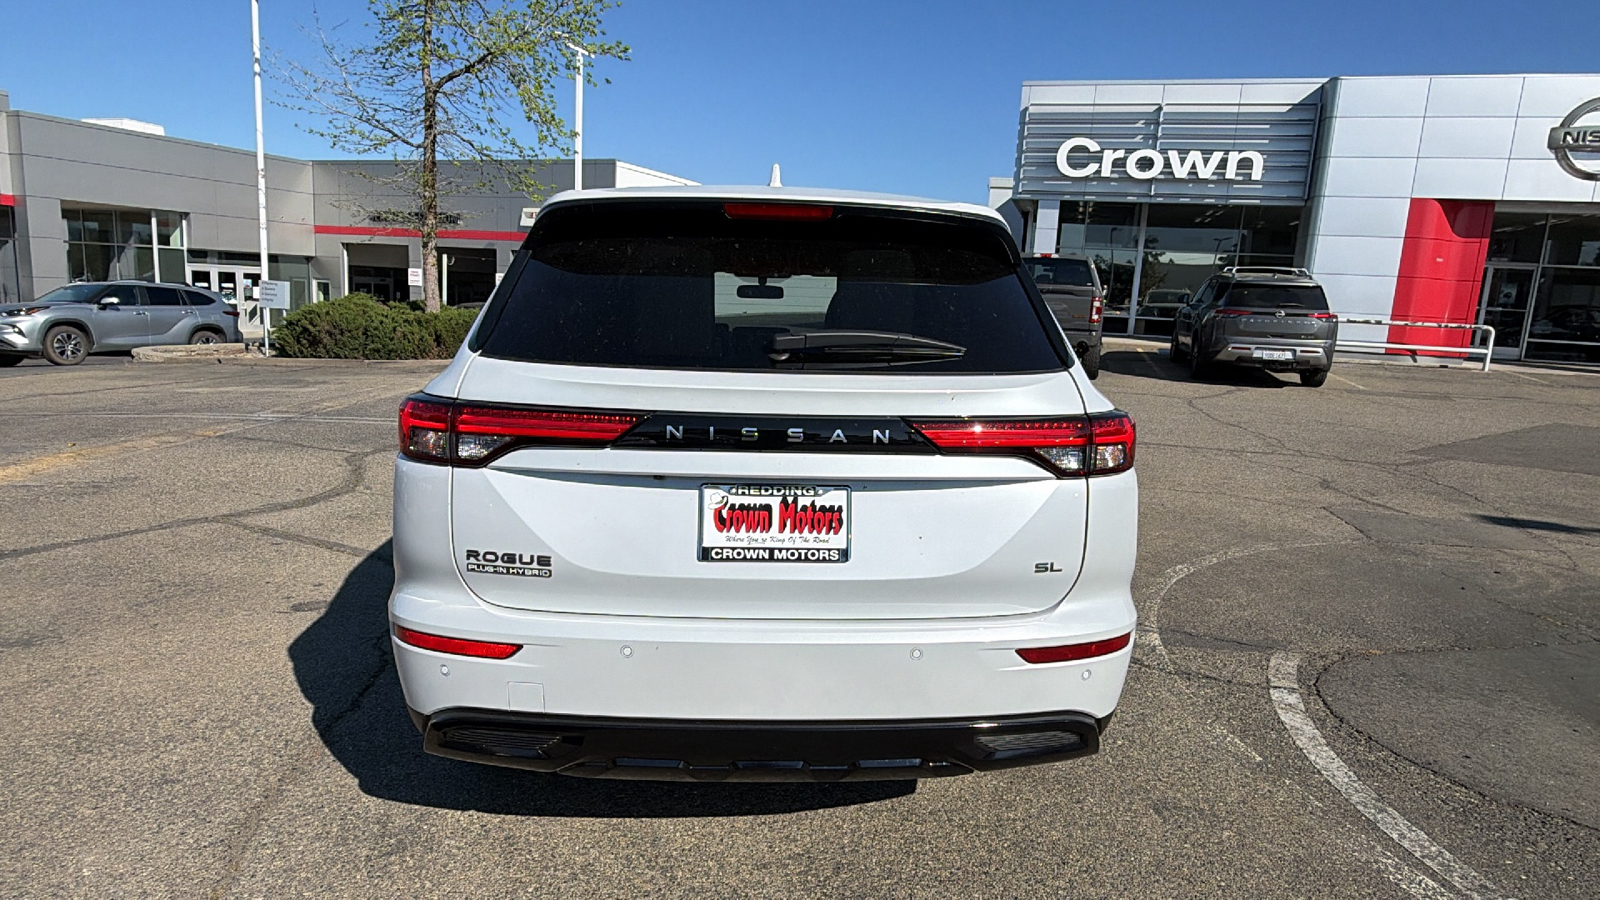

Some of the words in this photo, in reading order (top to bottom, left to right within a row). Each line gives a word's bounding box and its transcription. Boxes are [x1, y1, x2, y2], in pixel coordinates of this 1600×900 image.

[1056, 137, 1264, 181] Crown
[666, 425, 890, 444] NISSAN
[737, 486, 815, 496] REDDING
[713, 502, 772, 533] Crown
[778, 499, 843, 535] Motors
[725, 535, 745, 543] Where
[769, 536, 785, 544] King
[788, 536, 796, 545] Of
[466, 549, 552, 567] ROGUE
[711, 548, 770, 560] CROWN
[774, 548, 840, 561] MOTORS
[468, 564, 507, 574] PLUG-IN
[509, 567, 550, 577] HYBRID
[1034, 562, 1063, 573] SL
